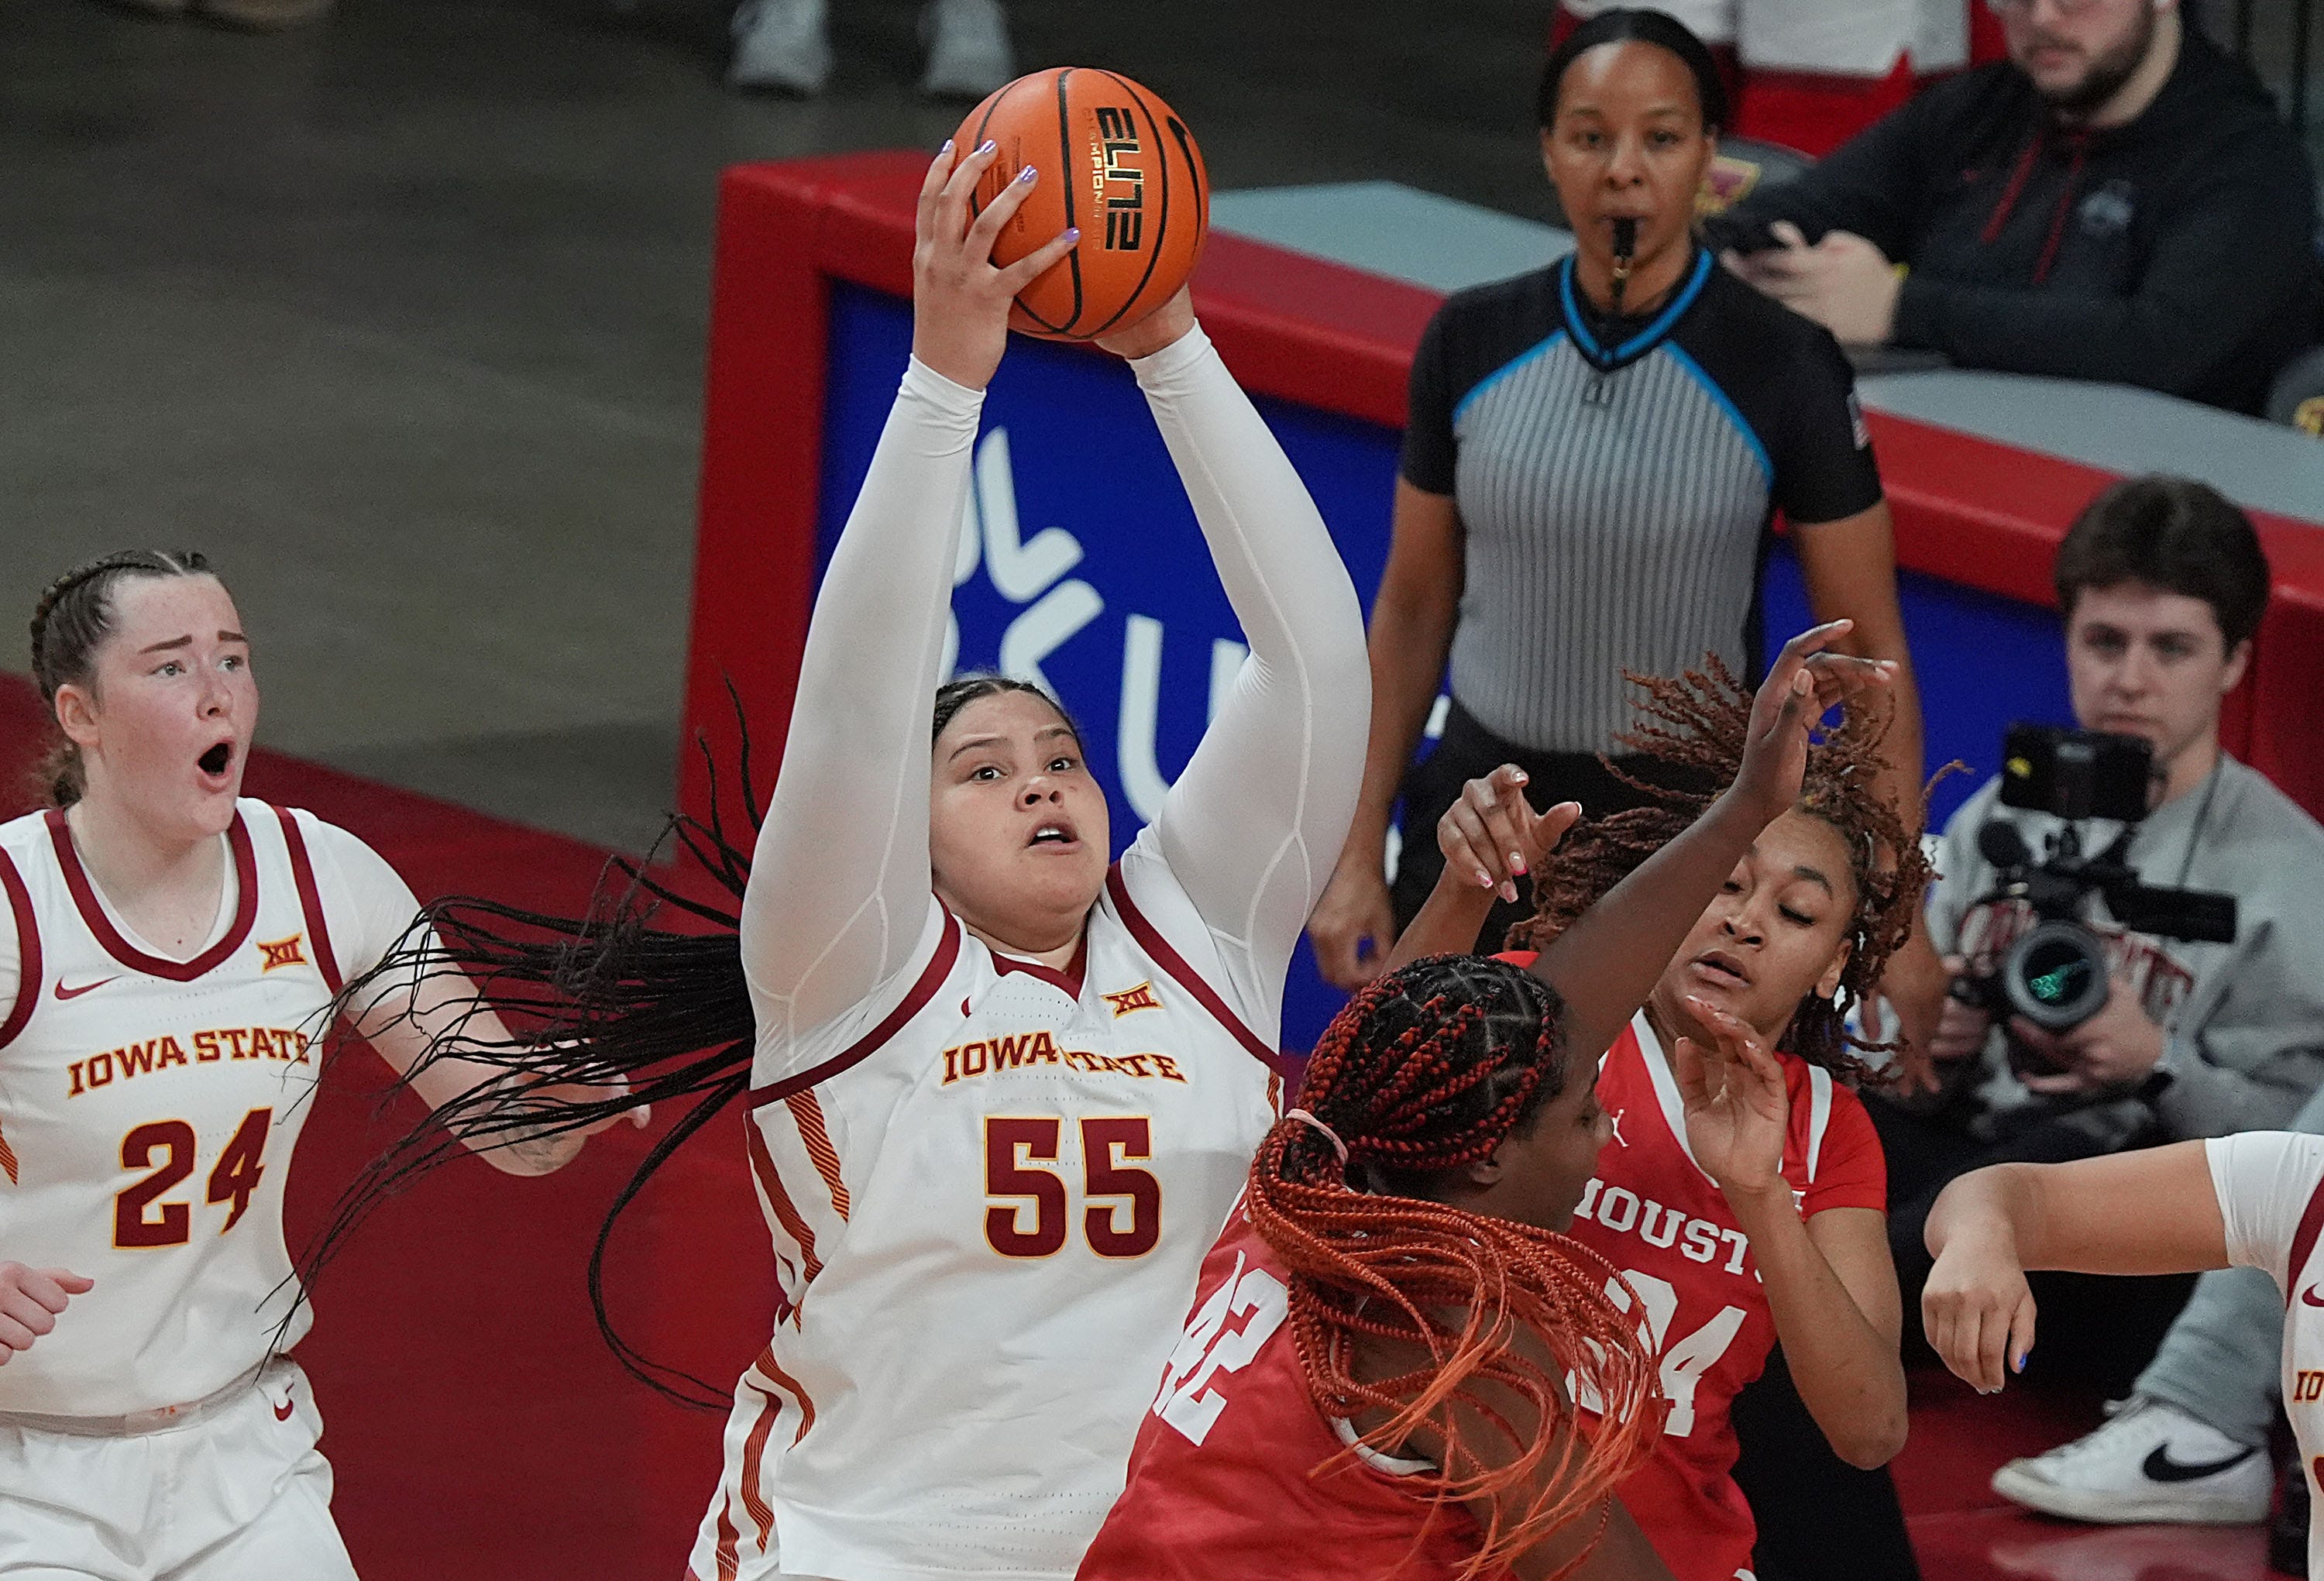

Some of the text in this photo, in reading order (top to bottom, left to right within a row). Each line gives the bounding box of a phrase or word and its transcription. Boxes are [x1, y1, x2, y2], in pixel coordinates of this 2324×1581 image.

[1096, 107, 1144, 251] ELITE
[256, 933, 308, 974] XII
[1099, 980, 1165, 1019] XII
[68, 1027, 311, 1099] IOWA STATE
[942, 1031, 1188, 1086] IOWA TATE
[112, 1106, 273, 1249] 24
[983, 1115, 1162, 1260] 55
[1573, 1177, 1762, 1284] OUST
